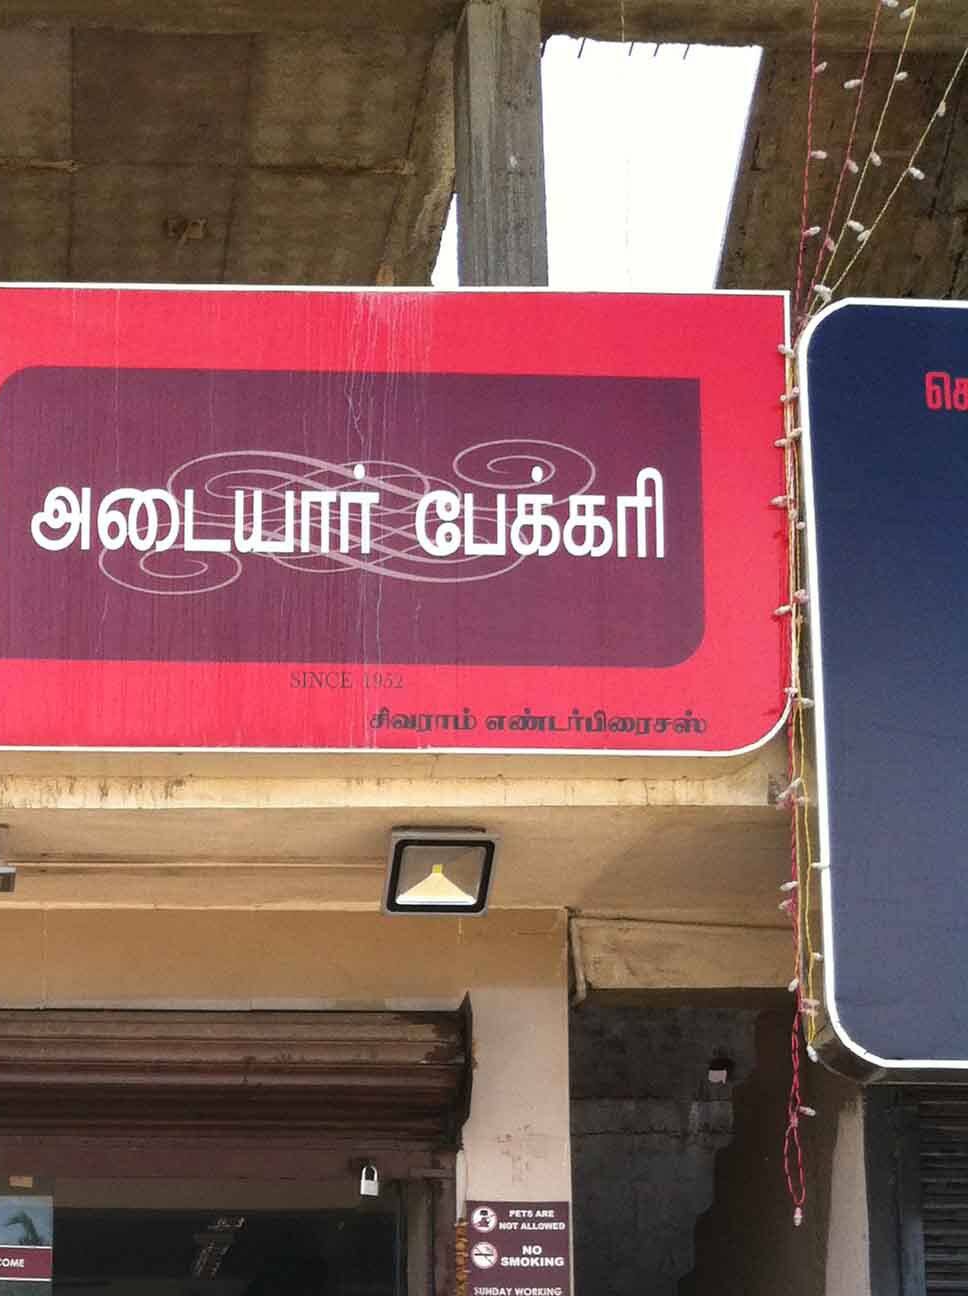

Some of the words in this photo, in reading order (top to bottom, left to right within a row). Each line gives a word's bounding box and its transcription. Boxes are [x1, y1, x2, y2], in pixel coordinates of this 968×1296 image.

[30, 462, 381, 554] அடையார்
[415, 465, 665, 559] பேக்கரி
[289, 671, 353, 689] SINCE
[363, 672, 404, 690] 1952
[369, 706, 477, 734] சிவராம்
[508, 1209, 533, 1218] PETS
[534, 1209, 555, 1218] ARE
[498, 1221, 519, 1231] NOT
[520, 1221, 567, 1231] ALLOWED
[521, 1245, 543, 1256] NO
[500, 1256, 565, 1267] SMOKING
[473, 1287, 512, 1296] SUNDAY
[514, 1287, 563, 1296] WORKING
